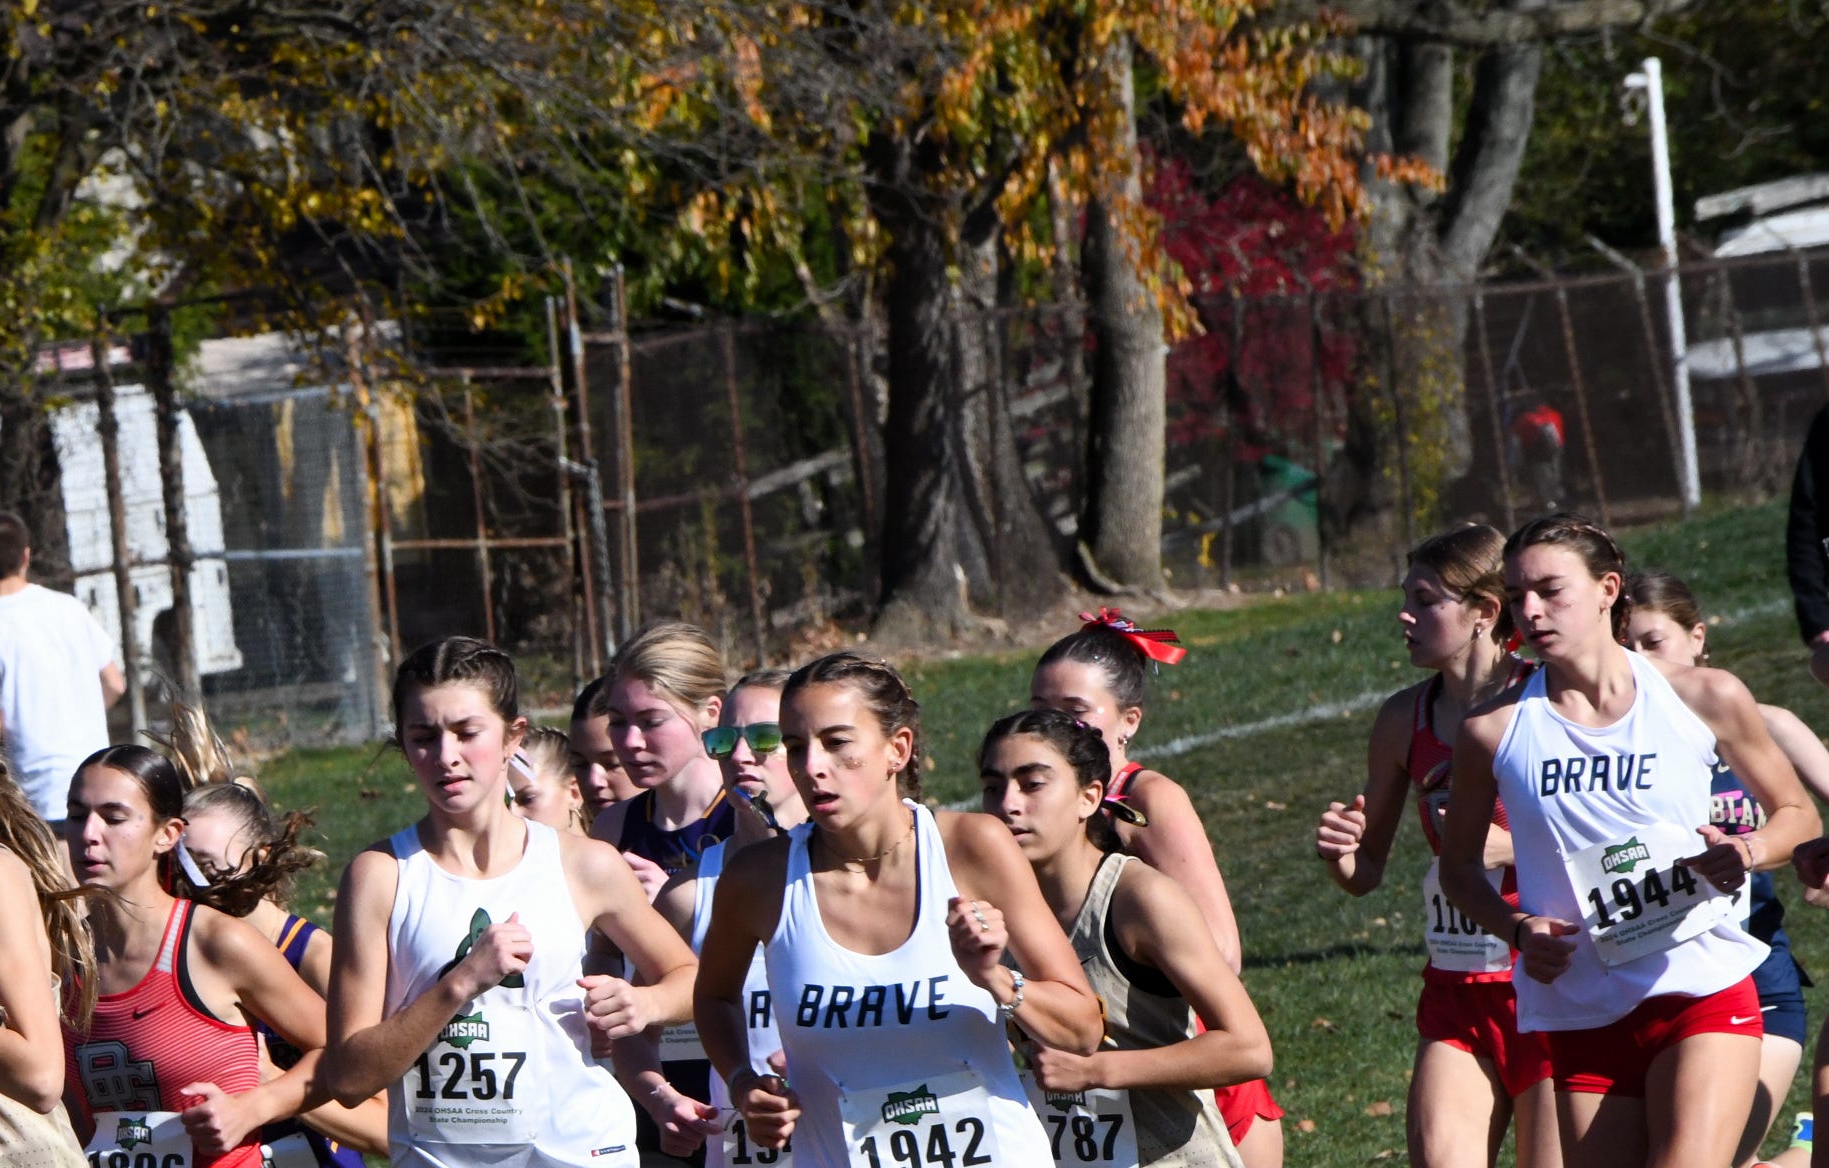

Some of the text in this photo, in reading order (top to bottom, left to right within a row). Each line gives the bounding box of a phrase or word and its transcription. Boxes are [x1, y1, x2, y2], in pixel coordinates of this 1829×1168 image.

[1541, 753, 1657, 797] BRAVE
[1604, 845, 1647, 870] OHSAA
[1588, 857, 1698, 930] 1944
[796, 974, 949, 1028] BRAVE
[414, 1051, 527, 1100] 1257
[429, 1116, 508, 1125] State Championship
[434, 1107, 463, 1115] OHSAA
[465, 1107, 489, 1116] Cross
[885, 1096, 938, 1121] OHSAA
[1048, 1113, 1124, 1162] 787
